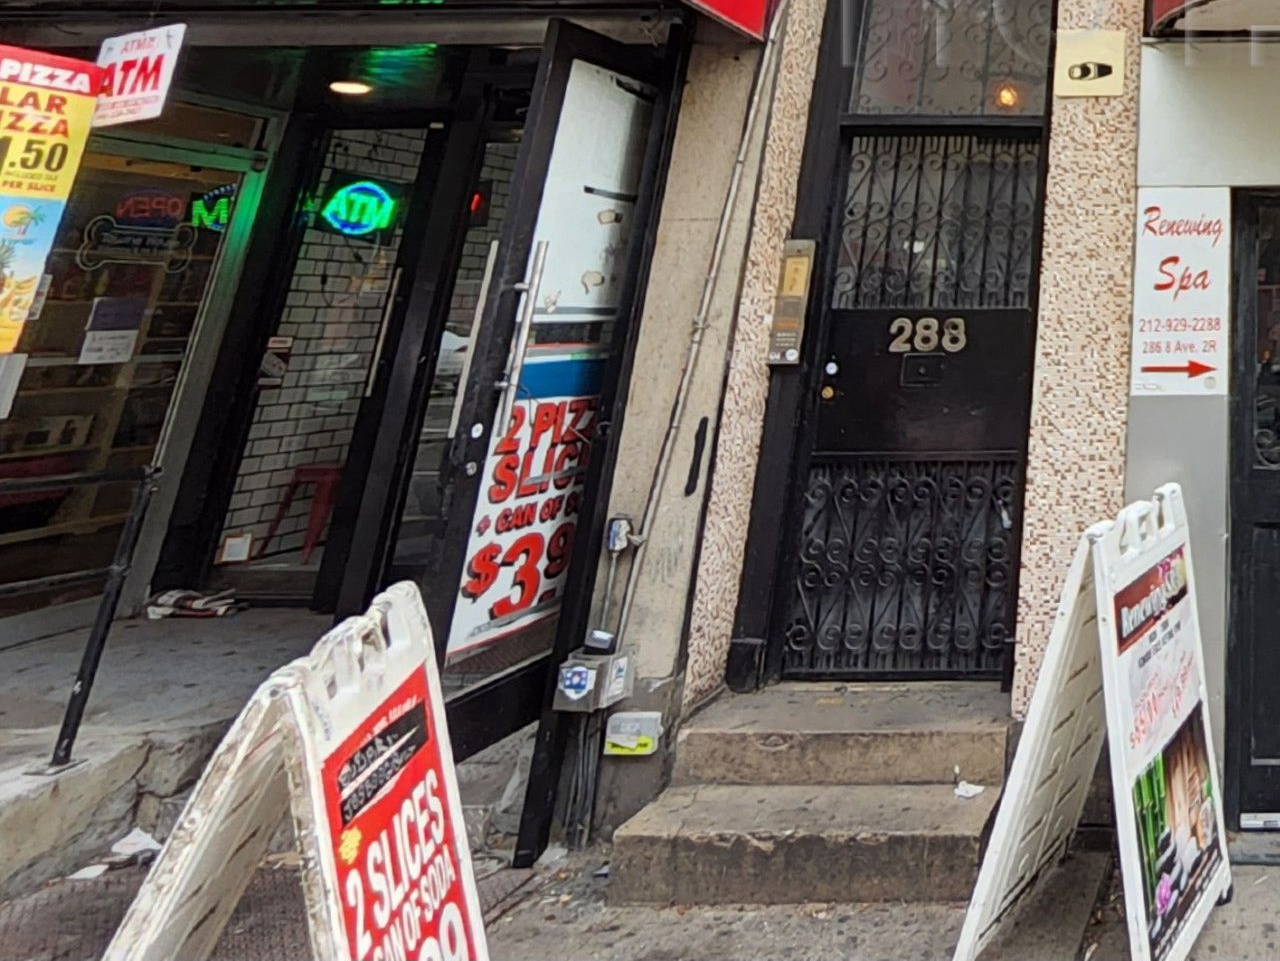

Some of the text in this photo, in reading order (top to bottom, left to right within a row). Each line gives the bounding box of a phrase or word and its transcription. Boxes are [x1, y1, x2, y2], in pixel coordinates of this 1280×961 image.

[0, 57, 92, 94] PIZZA
[97, 53, 166, 99] ATM
[1141, 205, 1225, 249] Renewing
[1152, 255, 1212, 303] Spa
[888, 316, 968, 354] 288
[1138, 316, 1222, 334] 212-929-2288
[1141, 340, 1162, 355] 286
[1164, 340, 1172, 355] 8
[1202, 339, 1218, 354] 2R
[493, 404, 527, 456] 2
[493, 500, 539, 536] CAN
[538, 494, 567, 524] OF
[345, 868, 373, 961] 2
[366, 768, 446, 930] SLICES
[402, 888, 422, 953] OF
[419, 843, 457, 924] SODA
